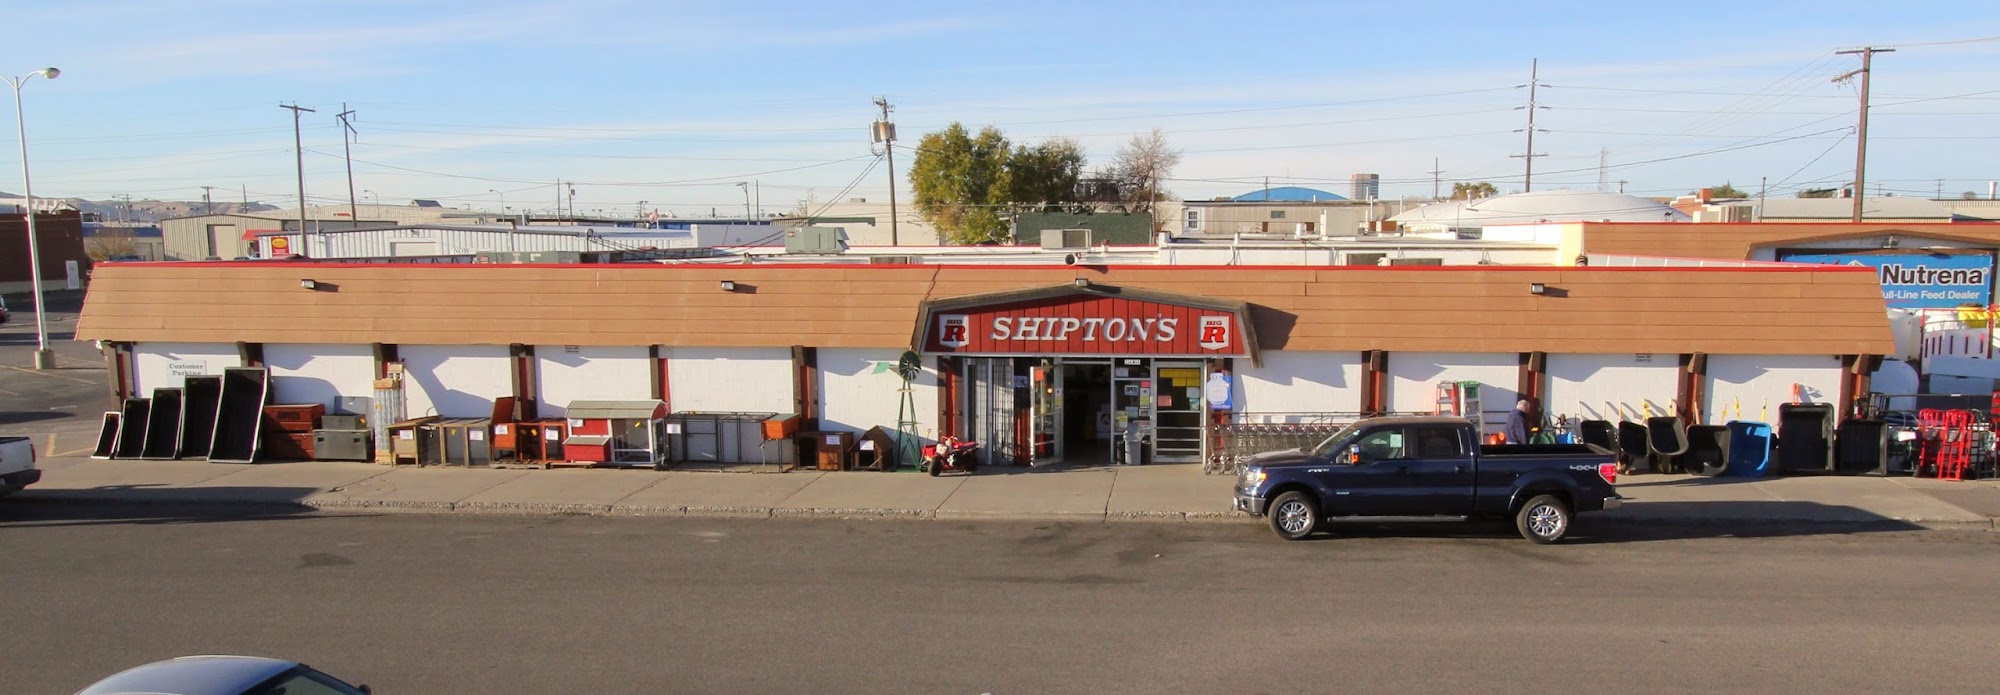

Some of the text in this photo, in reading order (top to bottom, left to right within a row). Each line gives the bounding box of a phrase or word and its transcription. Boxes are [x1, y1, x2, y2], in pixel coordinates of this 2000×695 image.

[1921, 290, 1945, 299] Feed
[1948, 290, 1980, 299] Dealer
[942, 325, 966, 341] R
[991, 313, 1178, 342] SHIPTON'S
[1201, 326, 1225, 343] R
